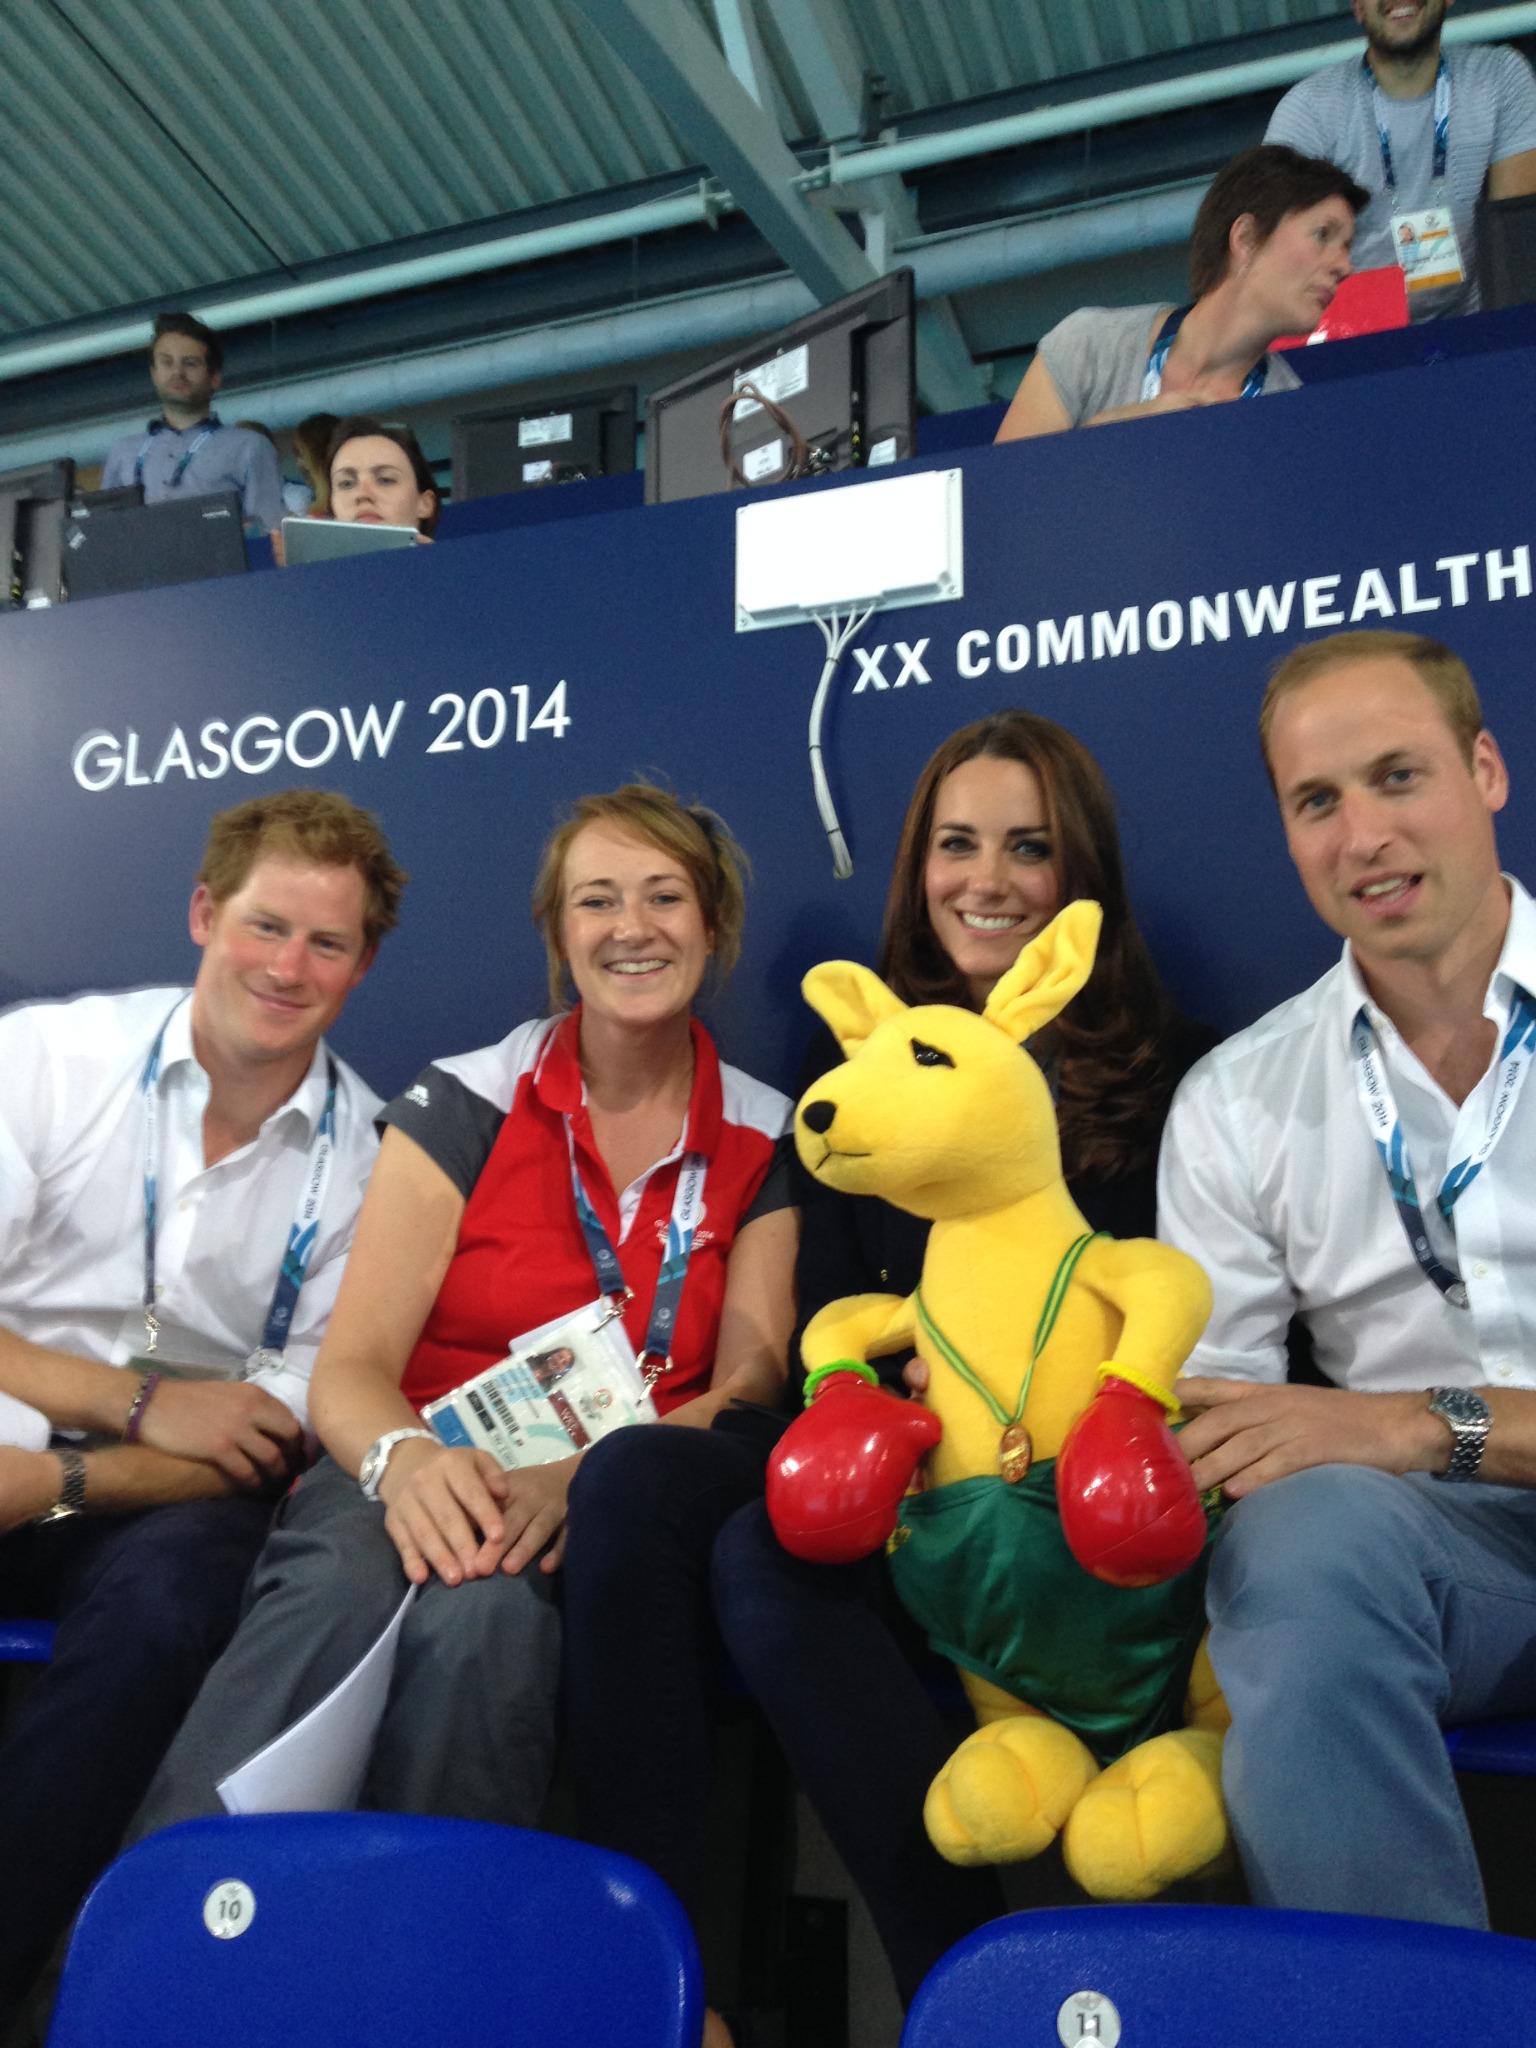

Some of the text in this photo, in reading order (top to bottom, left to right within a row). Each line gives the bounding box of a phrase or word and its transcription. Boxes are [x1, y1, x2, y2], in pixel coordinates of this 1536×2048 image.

[851, 545, 1534, 694] XX COMMONWEALTH
[72, 679, 572, 792] GLASGOW 2014
[1357, 1035, 1390, 1128] GLASGOW 2014
[1479, 1060, 1521, 1156] GLASGOW 2014
[309, 1144, 329, 1194] GLASGOW
[680, 1170, 698, 1221] GLASGOW
[219, 1900, 242, 1920] 10
[1076, 2012, 1101, 2037] 11
